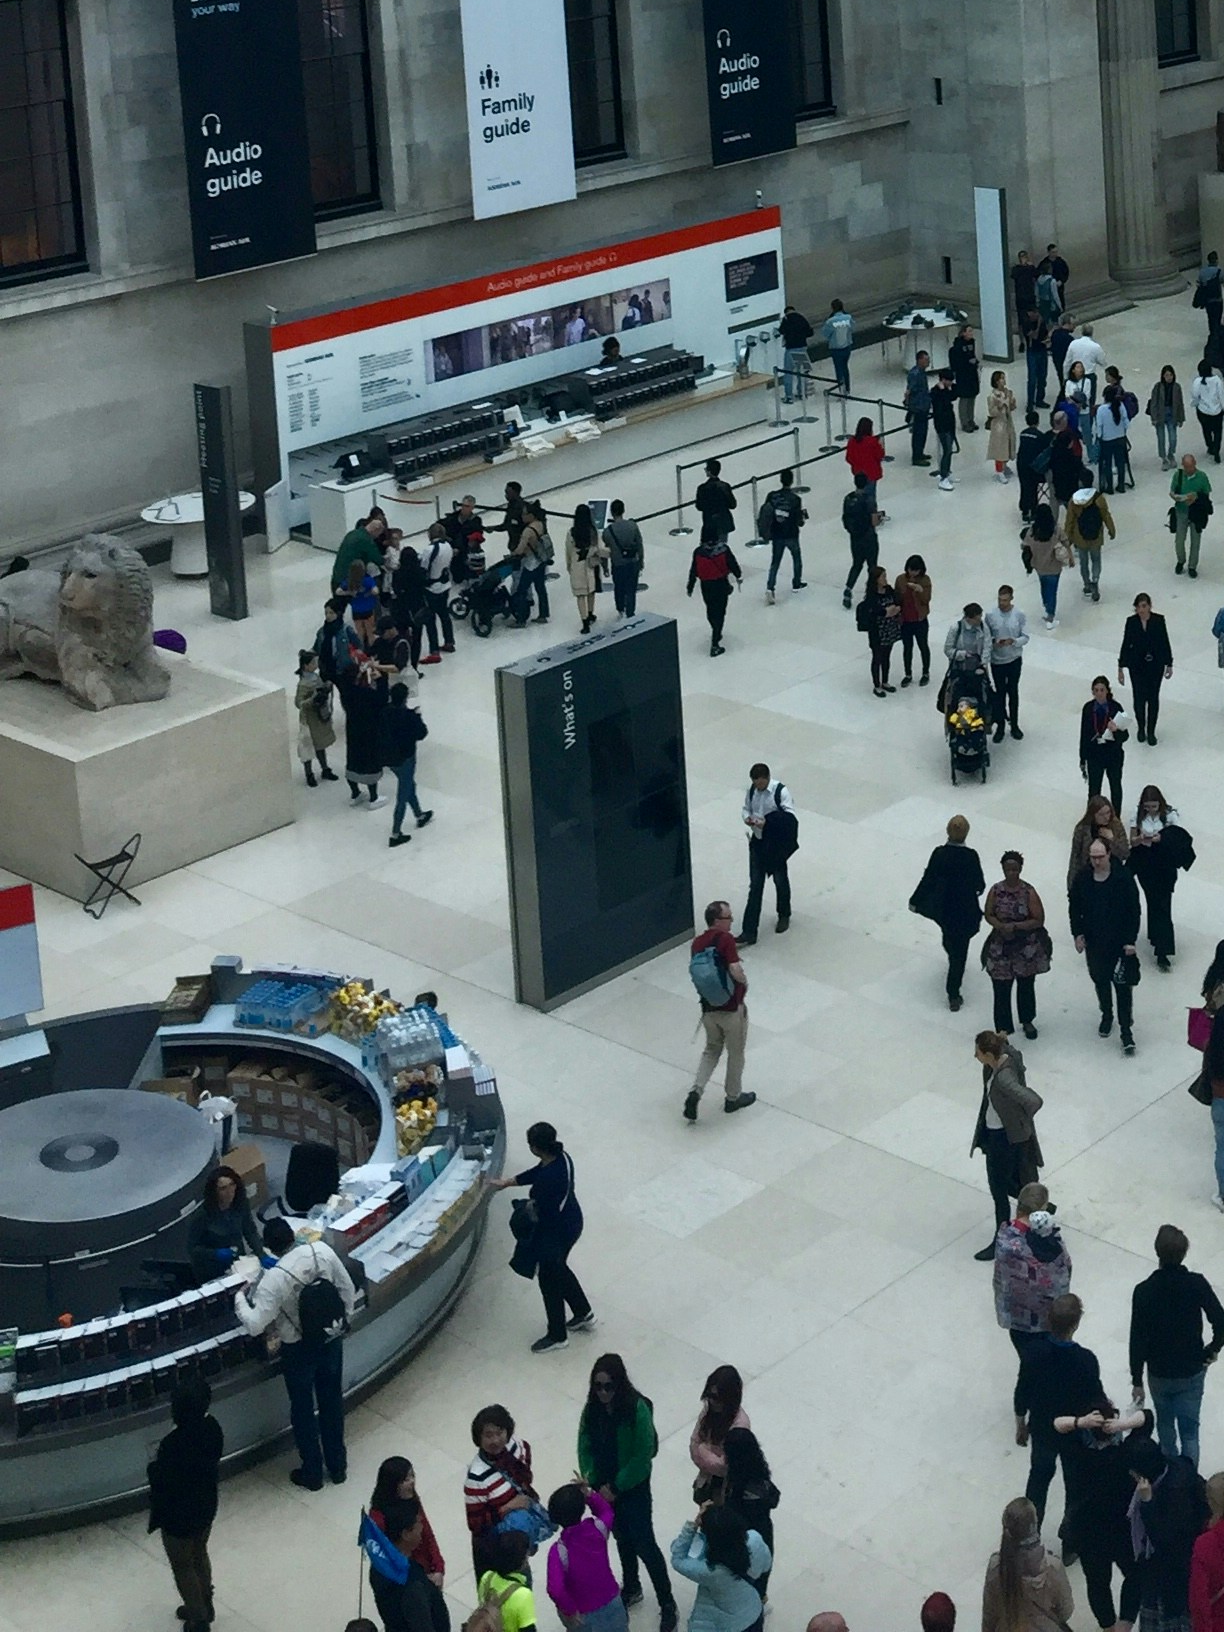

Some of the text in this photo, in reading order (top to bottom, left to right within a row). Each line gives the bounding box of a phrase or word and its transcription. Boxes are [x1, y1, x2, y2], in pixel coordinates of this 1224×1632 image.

[192, 1, 241, 18] your way
[719, 53, 759, 74] Audio
[720, 75, 759, 99] guide
[481, 93, 534, 116] Family
[483, 117, 531, 143] guide
[204, 142, 262, 168] Audio
[207, 168, 263, 197] guide
[487, 257, 606, 292] Audio guide and Family guide
[562, 670, 576, 749] What's on
